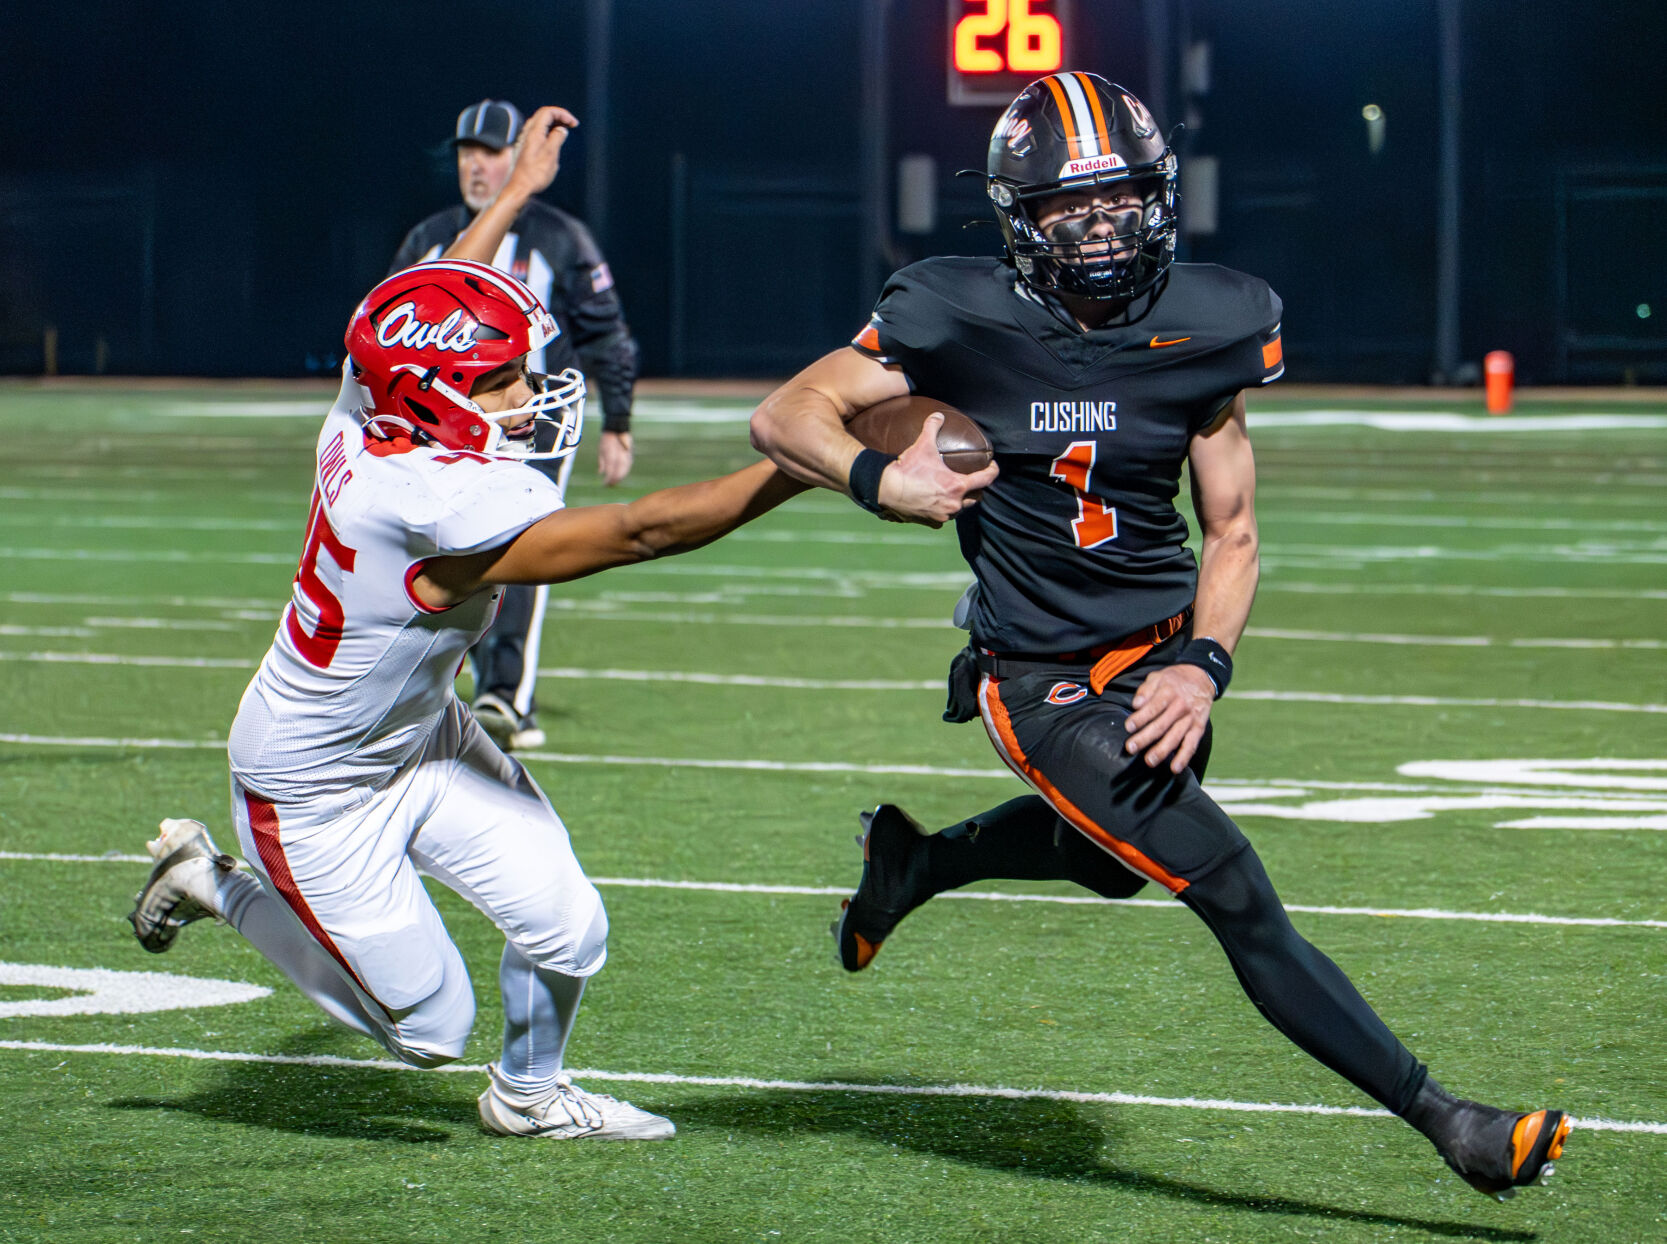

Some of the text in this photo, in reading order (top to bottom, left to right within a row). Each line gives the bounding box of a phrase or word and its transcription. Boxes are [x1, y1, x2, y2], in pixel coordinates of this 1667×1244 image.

[954, 0, 1062, 73] 26
[1069, 157, 1117, 174] Riddell
[376, 301, 477, 353] Owls
[1030, 401, 1117, 432] CUSHING
[319, 430, 353, 508] OWLS
[1049, 440, 1119, 550] 1
[286, 488, 357, 669] 5
